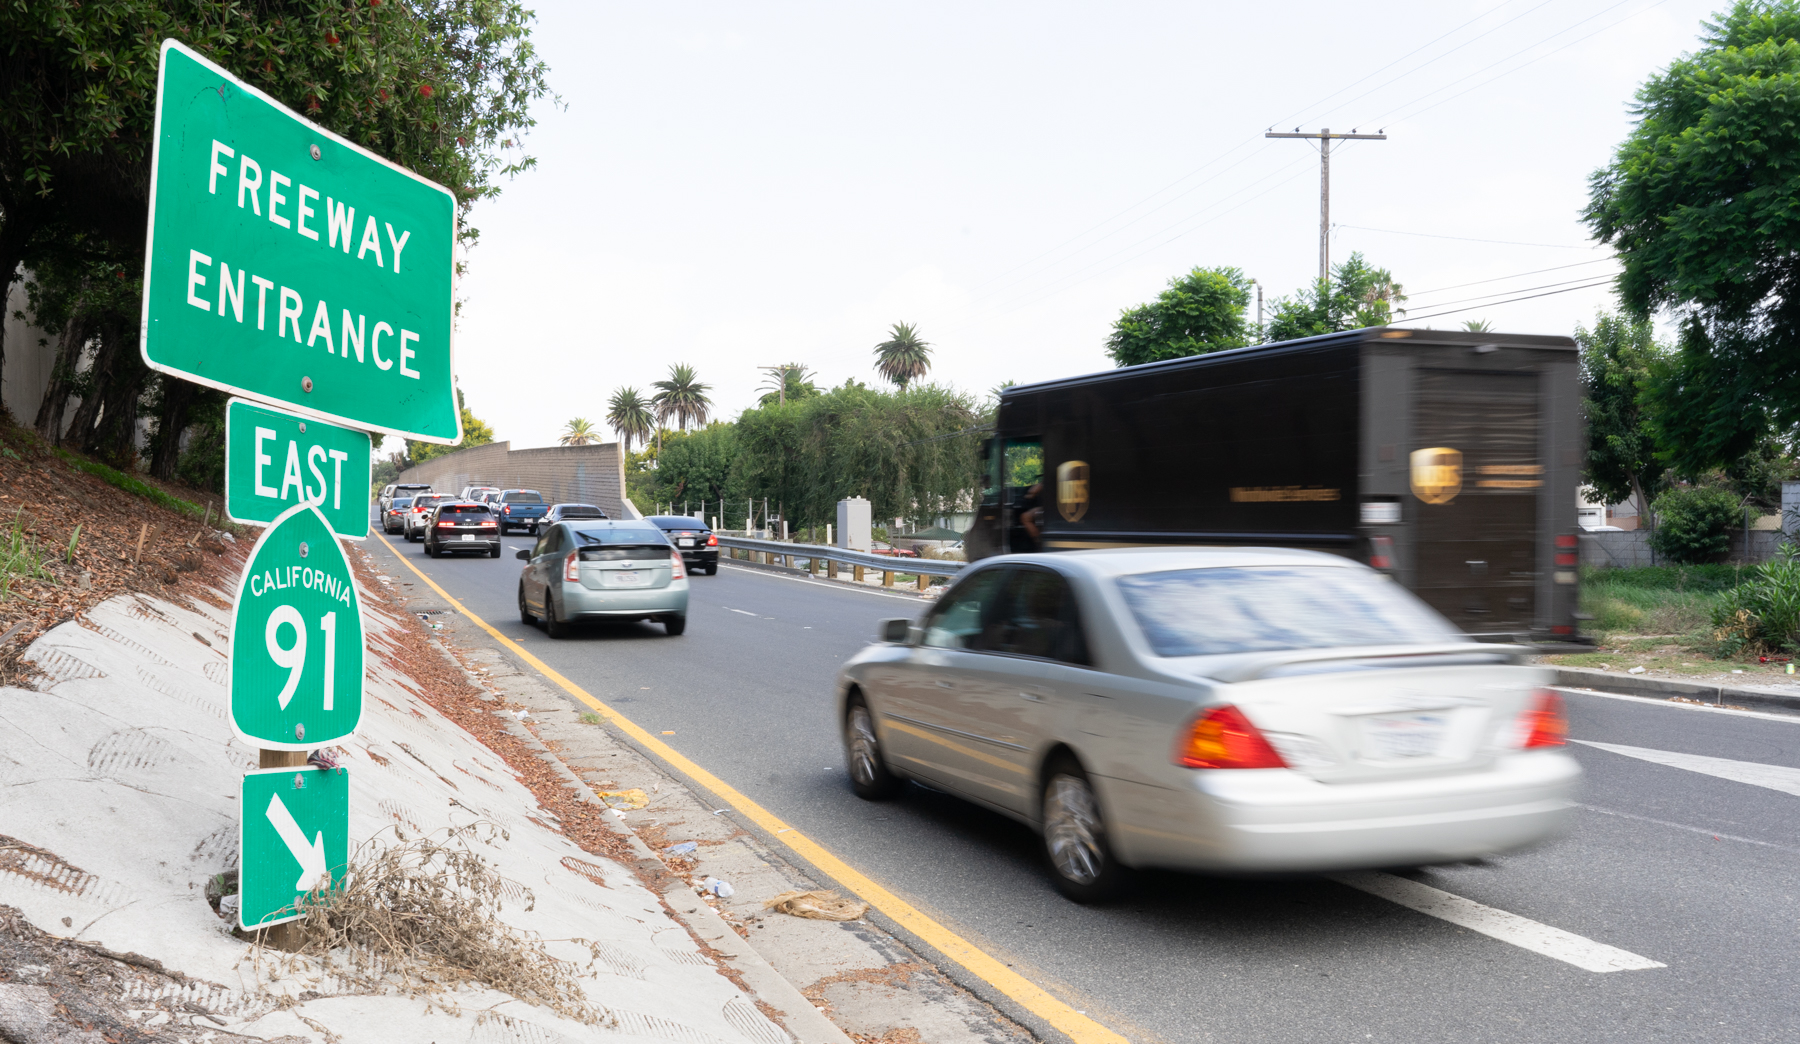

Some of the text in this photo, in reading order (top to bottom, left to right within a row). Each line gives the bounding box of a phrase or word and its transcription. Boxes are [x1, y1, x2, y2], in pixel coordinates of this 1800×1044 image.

[208, 139, 411, 274] FREEWAY
[187, 249, 421, 380] ENTRANCE
[255, 426, 348, 510] EAST
[250, 565, 351, 608] CALIFORNIA
[265, 604, 336, 711] 91
